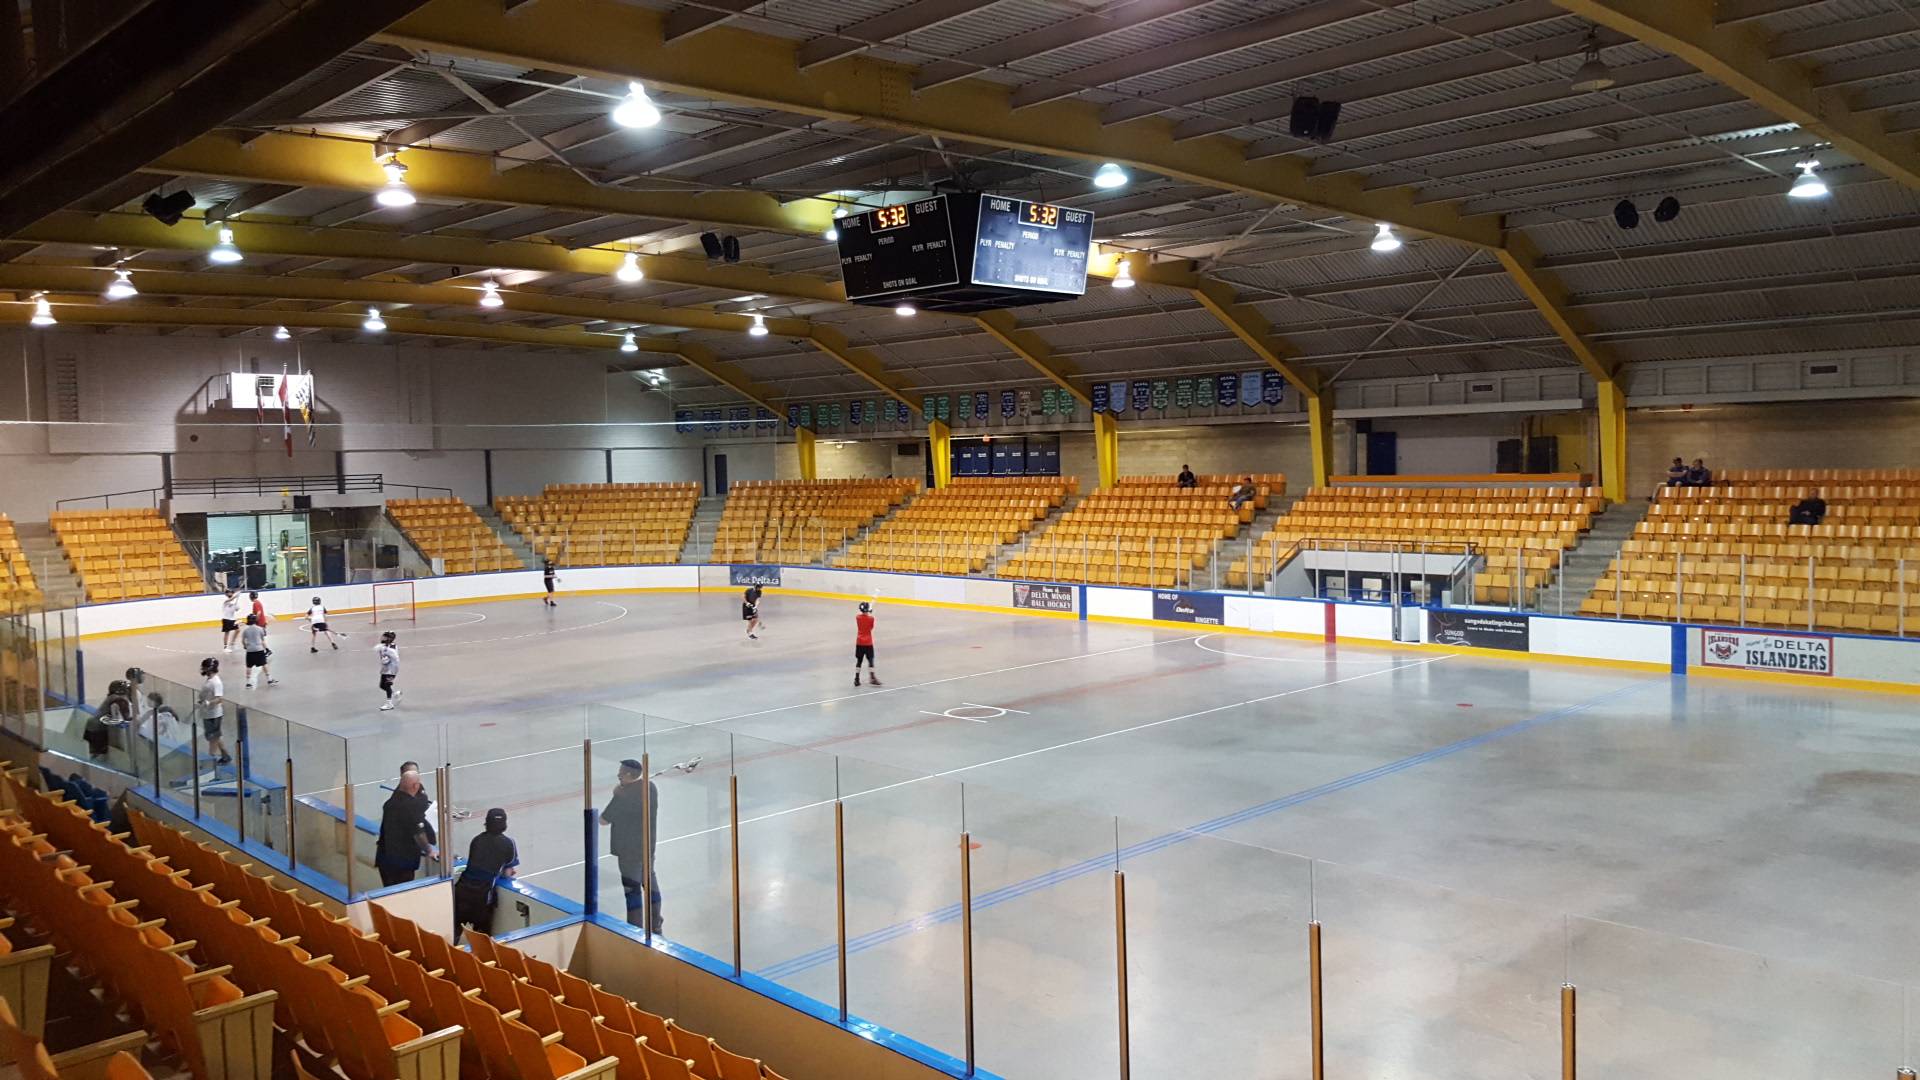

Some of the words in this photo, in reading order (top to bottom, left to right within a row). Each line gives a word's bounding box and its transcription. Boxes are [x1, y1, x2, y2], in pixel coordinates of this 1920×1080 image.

[914, 200, 938, 214] GUEST
[990, 199, 1010, 212] HOME
[878, 207, 906, 228] 5:32
[1030, 204, 1056, 226] 5:32
[1066, 212, 1086, 224] GUEST
[842, 216, 861, 229] HOME
[878, 236, 894, 246] PERIOD
[1022, 231, 1038, 240] PERIOD
[912, 244, 924, 252] PLYR
[926, 240, 946, 250] PENALTY
[980, 239, 992, 247] PLYR
[994, 240, 1015, 250] PENALTY
[841, 256, 852, 266] PLYR
[854, 253, 872, 262] PENALTY
[1054, 248, 1064, 257] PLYR
[1067, 250, 1085, 259] PENALTY
[882, 280, 897, 288] SHOTS
[905, 277, 918, 285] GOAL
[1014, 274, 1030, 282] SHOTS
[1036, 276, 1048, 286] GOAL
[752, 576, 779, 584] Delta.ca
[1176, 606, 1195, 614] Delta
[1195, 616, 1219, 624] RINGETTE
[1464, 618, 1526, 628] sungodskatingclub.com
[1708, 635, 1739, 647] ISLANDERS
[1774, 640, 1826, 652] DELTA
[1746, 650, 1827, 671] ISLANDERS
